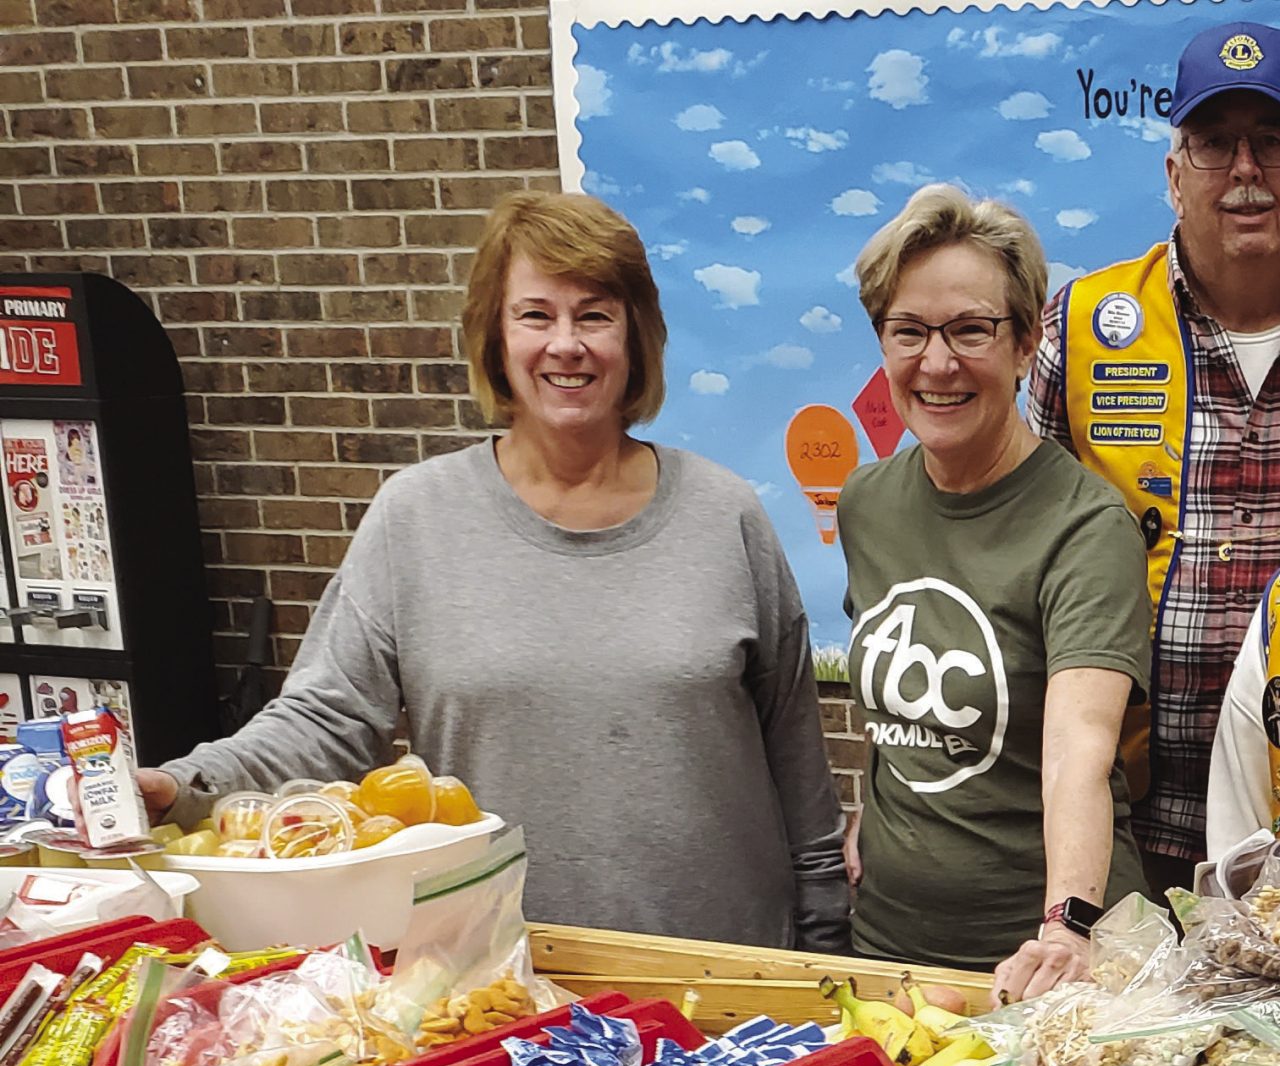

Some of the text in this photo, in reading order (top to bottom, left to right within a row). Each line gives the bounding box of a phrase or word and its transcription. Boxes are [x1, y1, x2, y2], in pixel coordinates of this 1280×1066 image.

[1235, 45, 1249, 59] L
[1077, 68, 1173, 119] You're
[4, 299, 66, 318] PRIMARY
[1104, 366, 1158, 378] PRESIDENT
[1096, 395, 1164, 407] VICE PRESIDENT
[1093, 426, 1160, 439] LION OF THE YEAR
[800, 441, 843, 461] 2302
[6, 452, 49, 474] HERE
